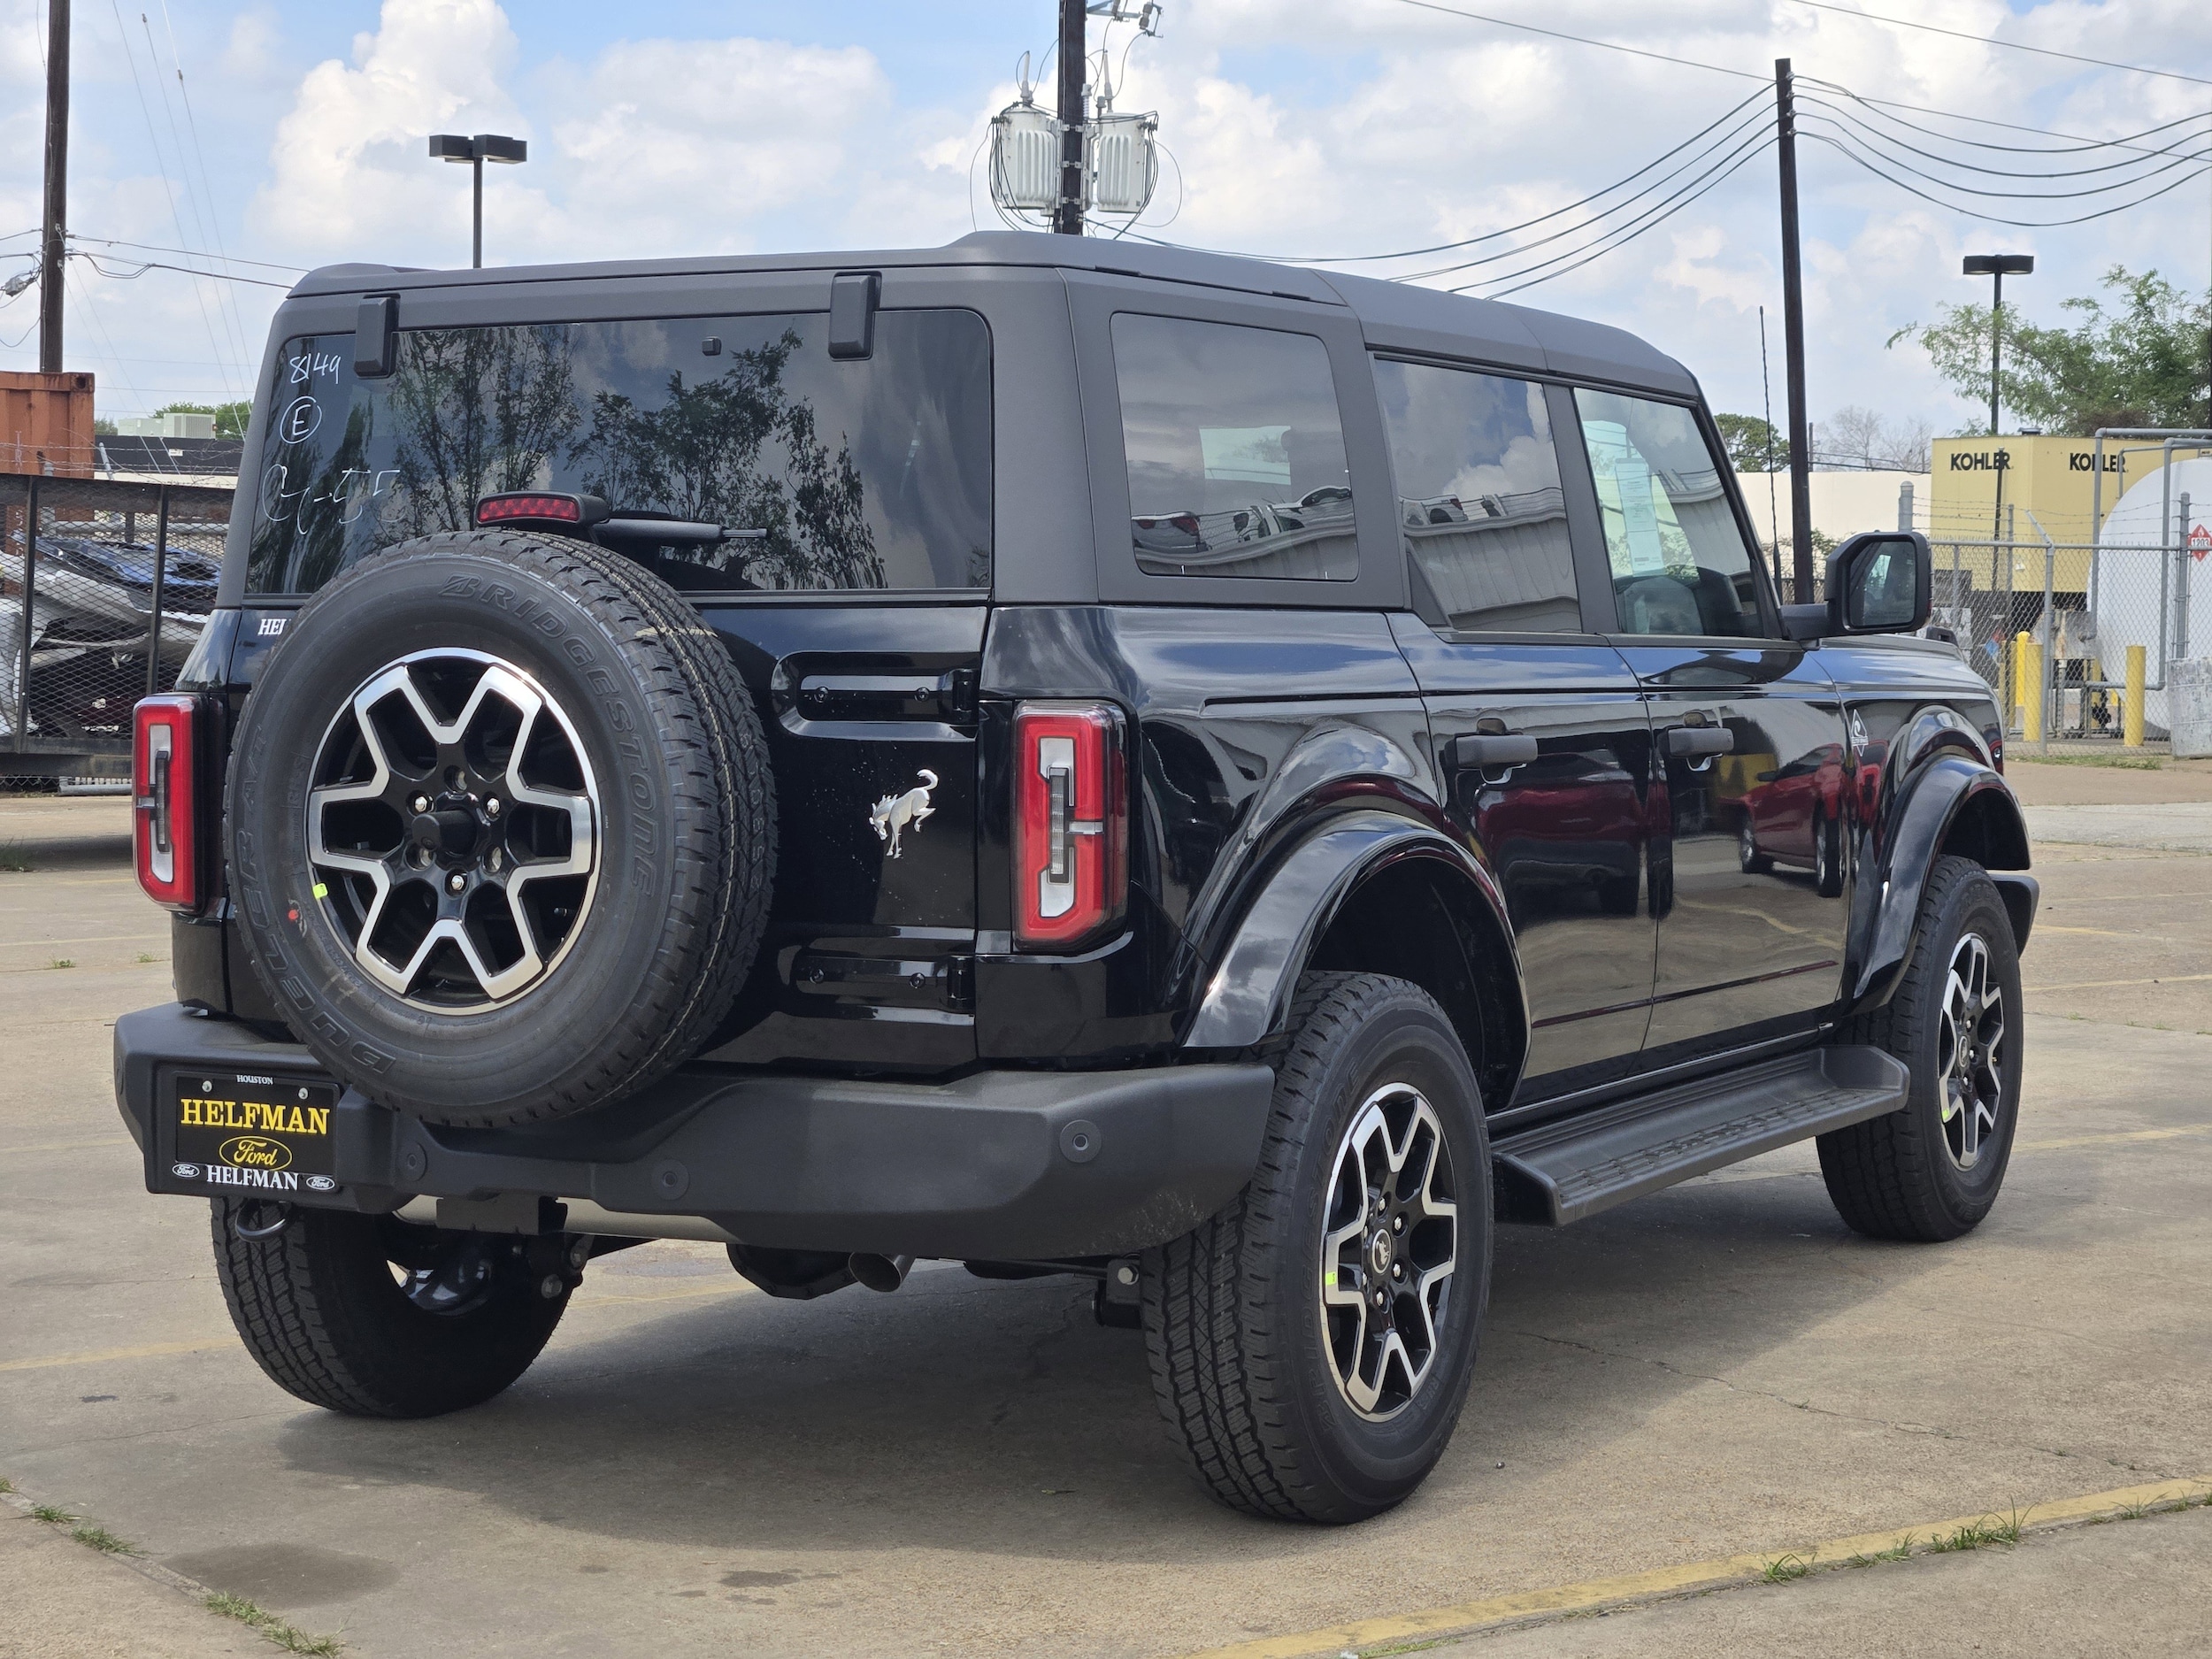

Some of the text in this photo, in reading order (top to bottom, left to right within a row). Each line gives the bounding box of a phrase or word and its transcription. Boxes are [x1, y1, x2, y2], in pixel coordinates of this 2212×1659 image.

[289, 352, 341, 384] 8149
[1950, 452, 2011, 471] KOHLER
[439, 573, 661, 898] BRIDGESTONE
[236, 828, 397, 1073] DUELER
[236, 1074, 273, 1085] HOUSTON
[180, 1098, 330, 1135] HELFMAN
[233, 1139, 278, 1166] Ford
[177, 1164, 330, 1191] Ford HELFMAN Ford
[1297, 1059, 1361, 1432] BRIDGESTONE
